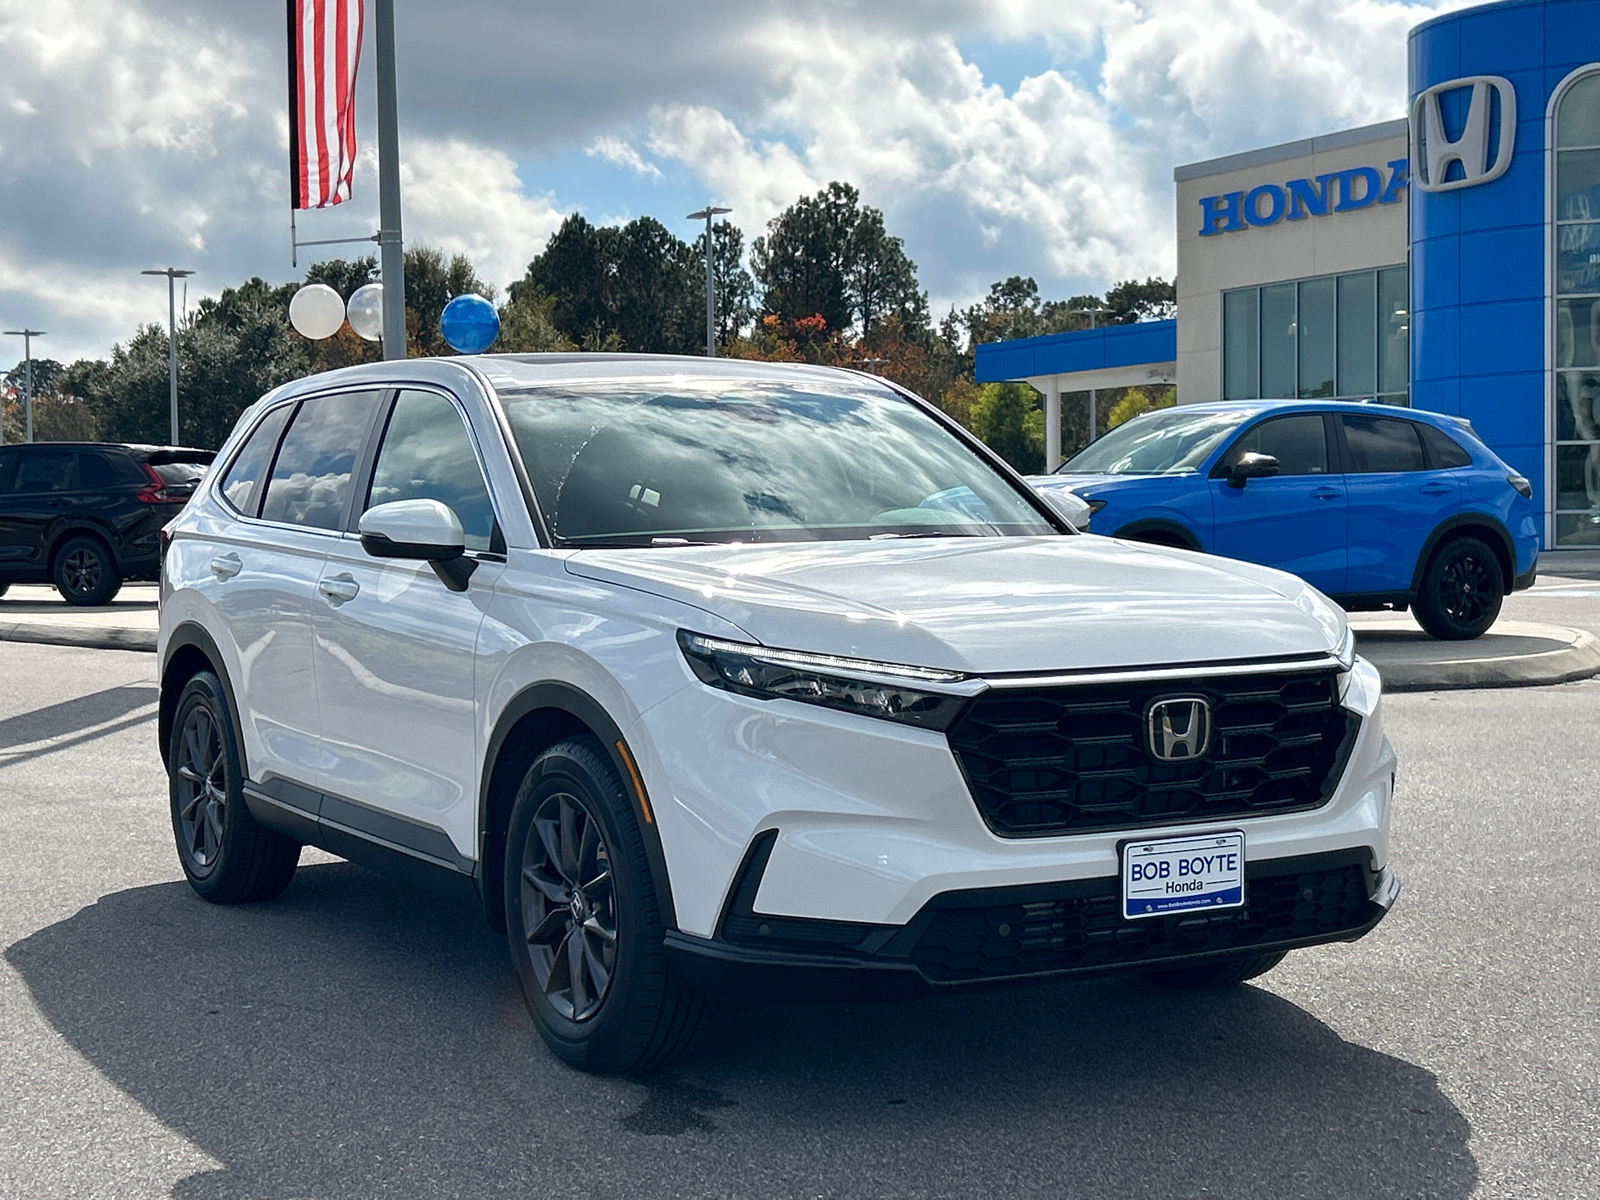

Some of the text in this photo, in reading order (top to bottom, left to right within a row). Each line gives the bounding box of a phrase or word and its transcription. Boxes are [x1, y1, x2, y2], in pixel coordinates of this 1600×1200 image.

[1198, 158, 1408, 237] HONDA
[1131, 853, 1238, 882] BOB BOYTE
[1165, 879, 1204, 894] Honda
